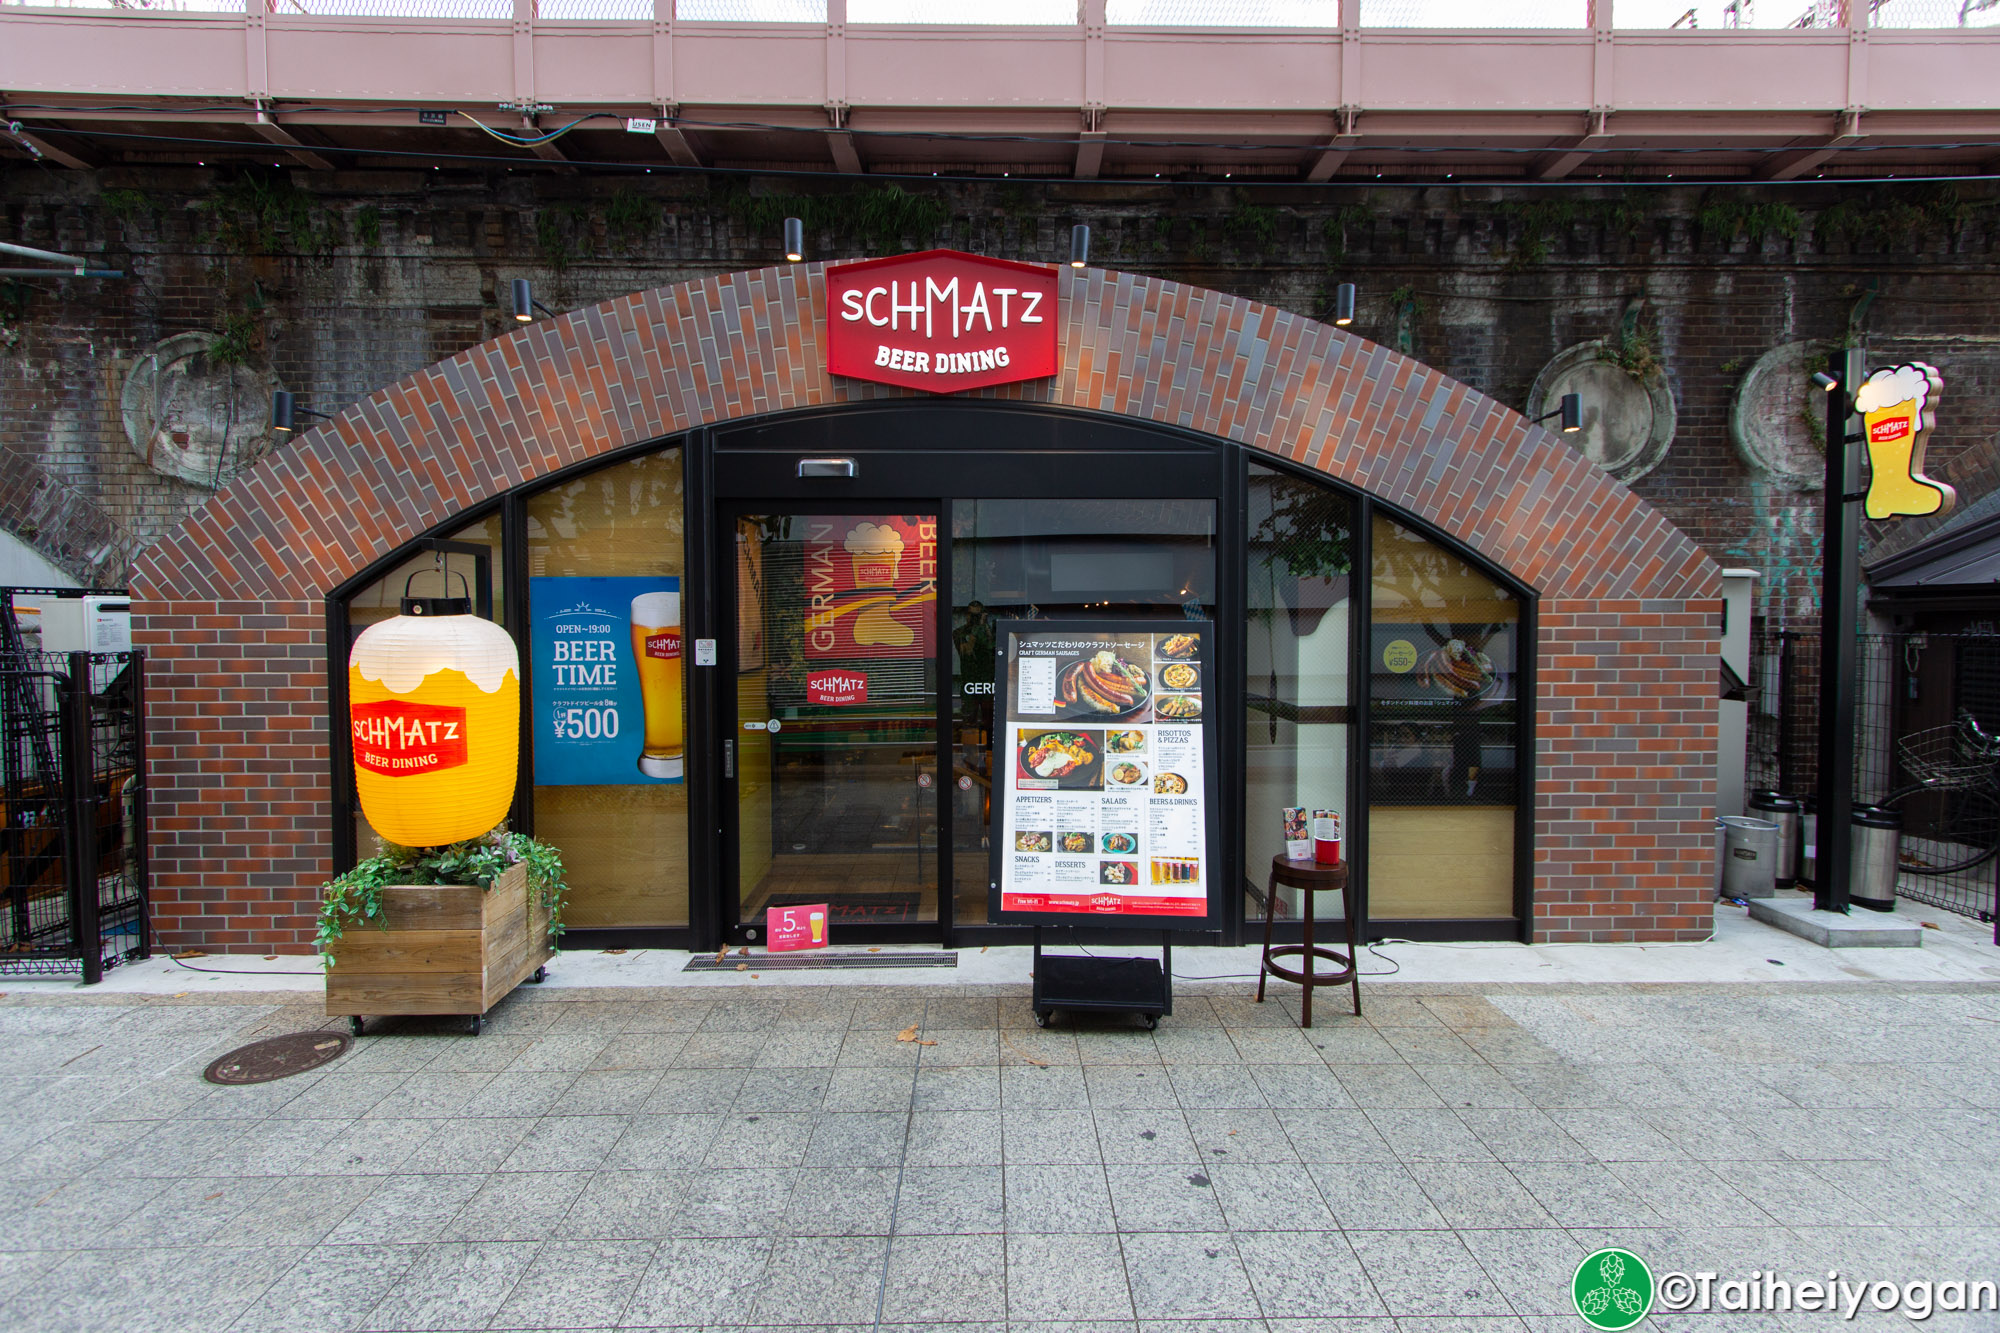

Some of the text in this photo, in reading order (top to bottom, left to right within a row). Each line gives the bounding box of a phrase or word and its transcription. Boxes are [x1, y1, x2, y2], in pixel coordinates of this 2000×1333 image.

[841, 276, 1043, 338] SCHMATZ
[874, 345, 1010, 374] BEER DINING
[1872, 421, 1908, 434] SCHMATZ
[920, 524, 936, 592] BEER
[811, 523, 835, 651] GERMAN
[553, 640, 616, 661] BEER
[648, 638, 680, 650] SCHMAT
[552, 665, 616, 685] TIME
[810, 676, 864, 693] SCHMATZ
[964, 682, 995, 694] GER
[354, 716, 460, 750] SCHMATZ
[553, 708, 619, 738] ¥500
[365, 752, 438, 768] BEER DINING
[829, 904, 897, 917] MATZ
[1091, 896, 1121, 906] SCHMATZ
[783, 910, 796, 932] 5
